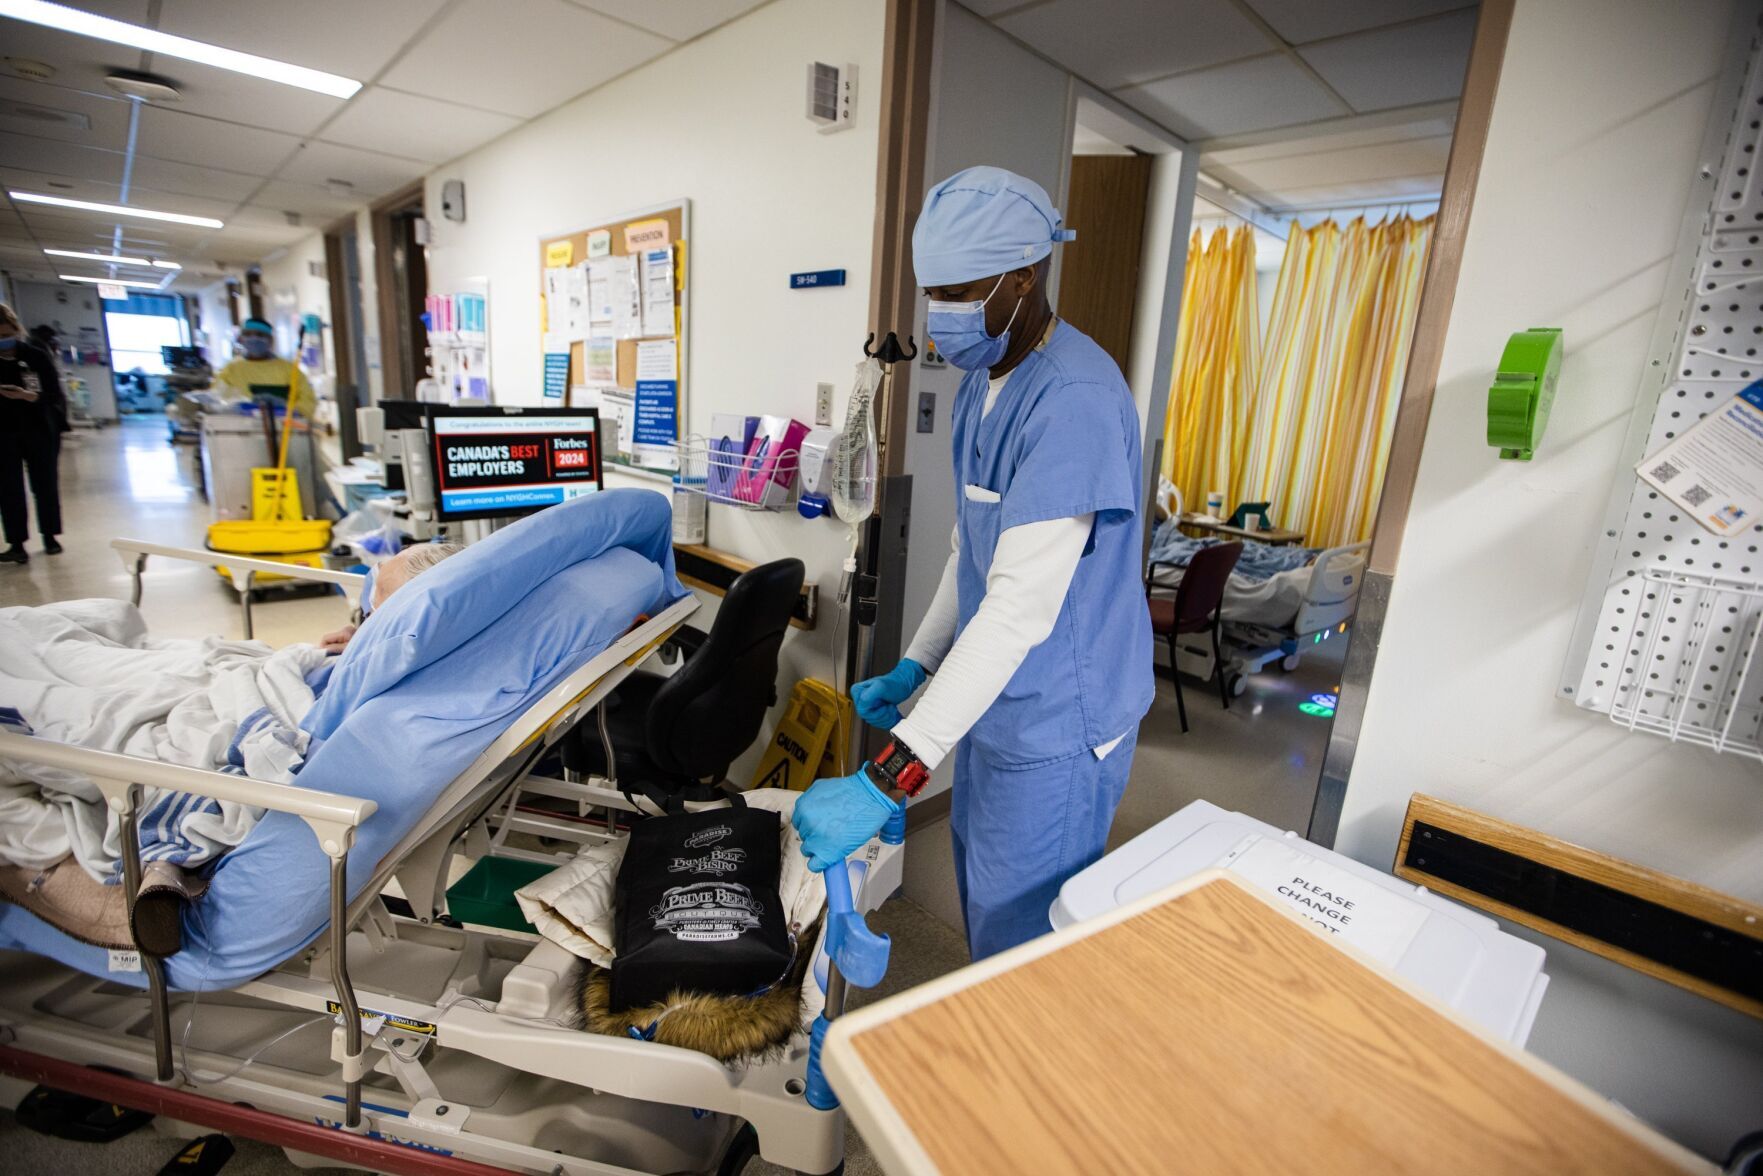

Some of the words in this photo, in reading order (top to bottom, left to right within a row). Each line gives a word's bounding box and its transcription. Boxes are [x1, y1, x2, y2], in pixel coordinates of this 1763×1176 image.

[629, 229, 664, 243] PREVENTION
[553, 438, 588, 450] Forbes
[447, 446, 510, 461] CANADA'S
[510, 445, 540, 459] BEST
[559, 452, 585, 465] 2024
[448, 460, 525, 477] EMPLOYERS
[450, 497, 472, 506] Learn
[473, 496, 494, 504] more
[776, 731, 809, 765] CAUTION
[674, 854, 710, 868] PRIME
[711, 850, 741, 862] BEEF
[698, 859, 738, 872] BISTRO
[668, 892, 714, 908] PRIME
[715, 888, 749, 906] BEEF
[1292, 877, 1355, 910] PLEASE
[1277, 886, 1352, 925] CHANGE
